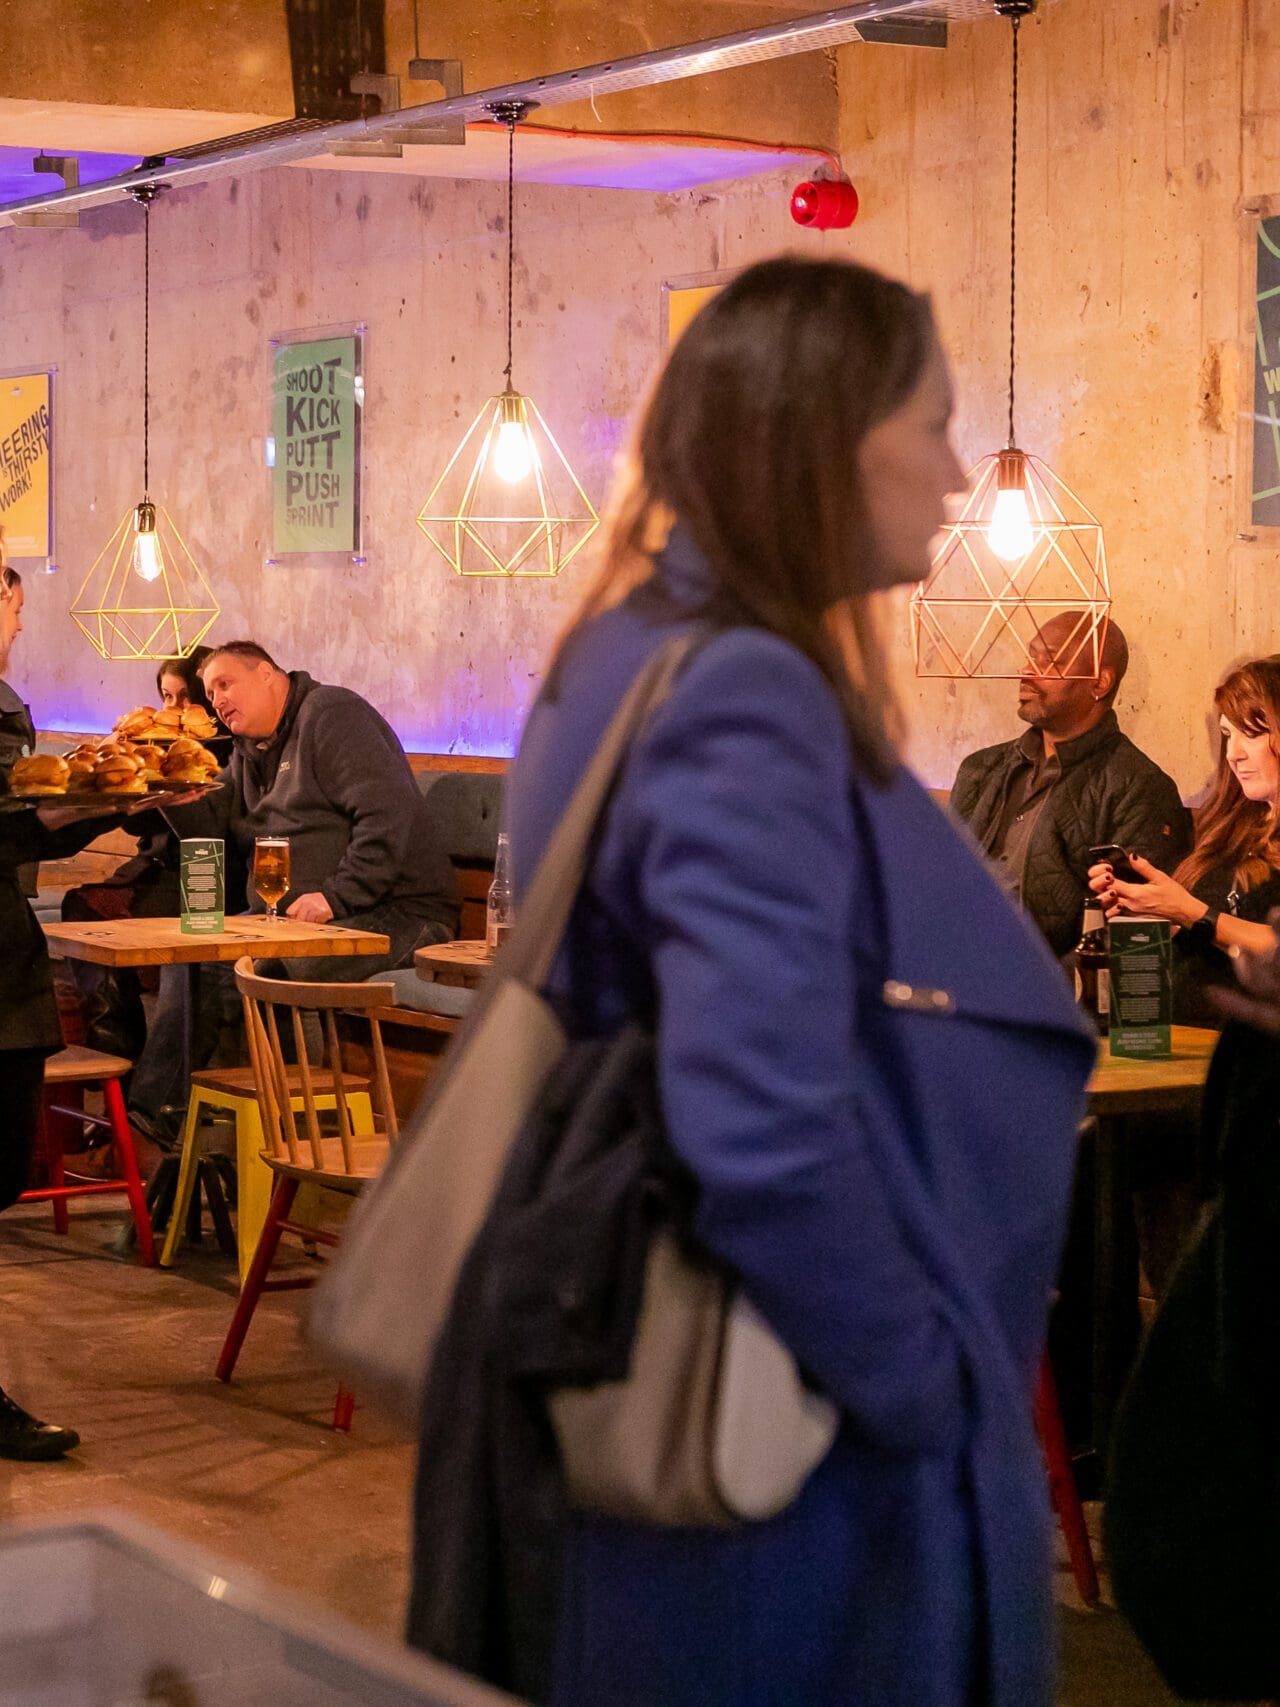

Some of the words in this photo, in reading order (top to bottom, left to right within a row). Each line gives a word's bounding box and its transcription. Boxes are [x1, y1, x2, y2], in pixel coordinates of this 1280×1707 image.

[286, 358, 342, 395] SHOOT
[286, 396, 341, 437] KICK
[7, 429, 50, 482] THIRSTY
[286, 430, 341, 470] PUTT
[286, 470, 340, 507] PUSH
[286, 501, 340, 529] SPRINT
